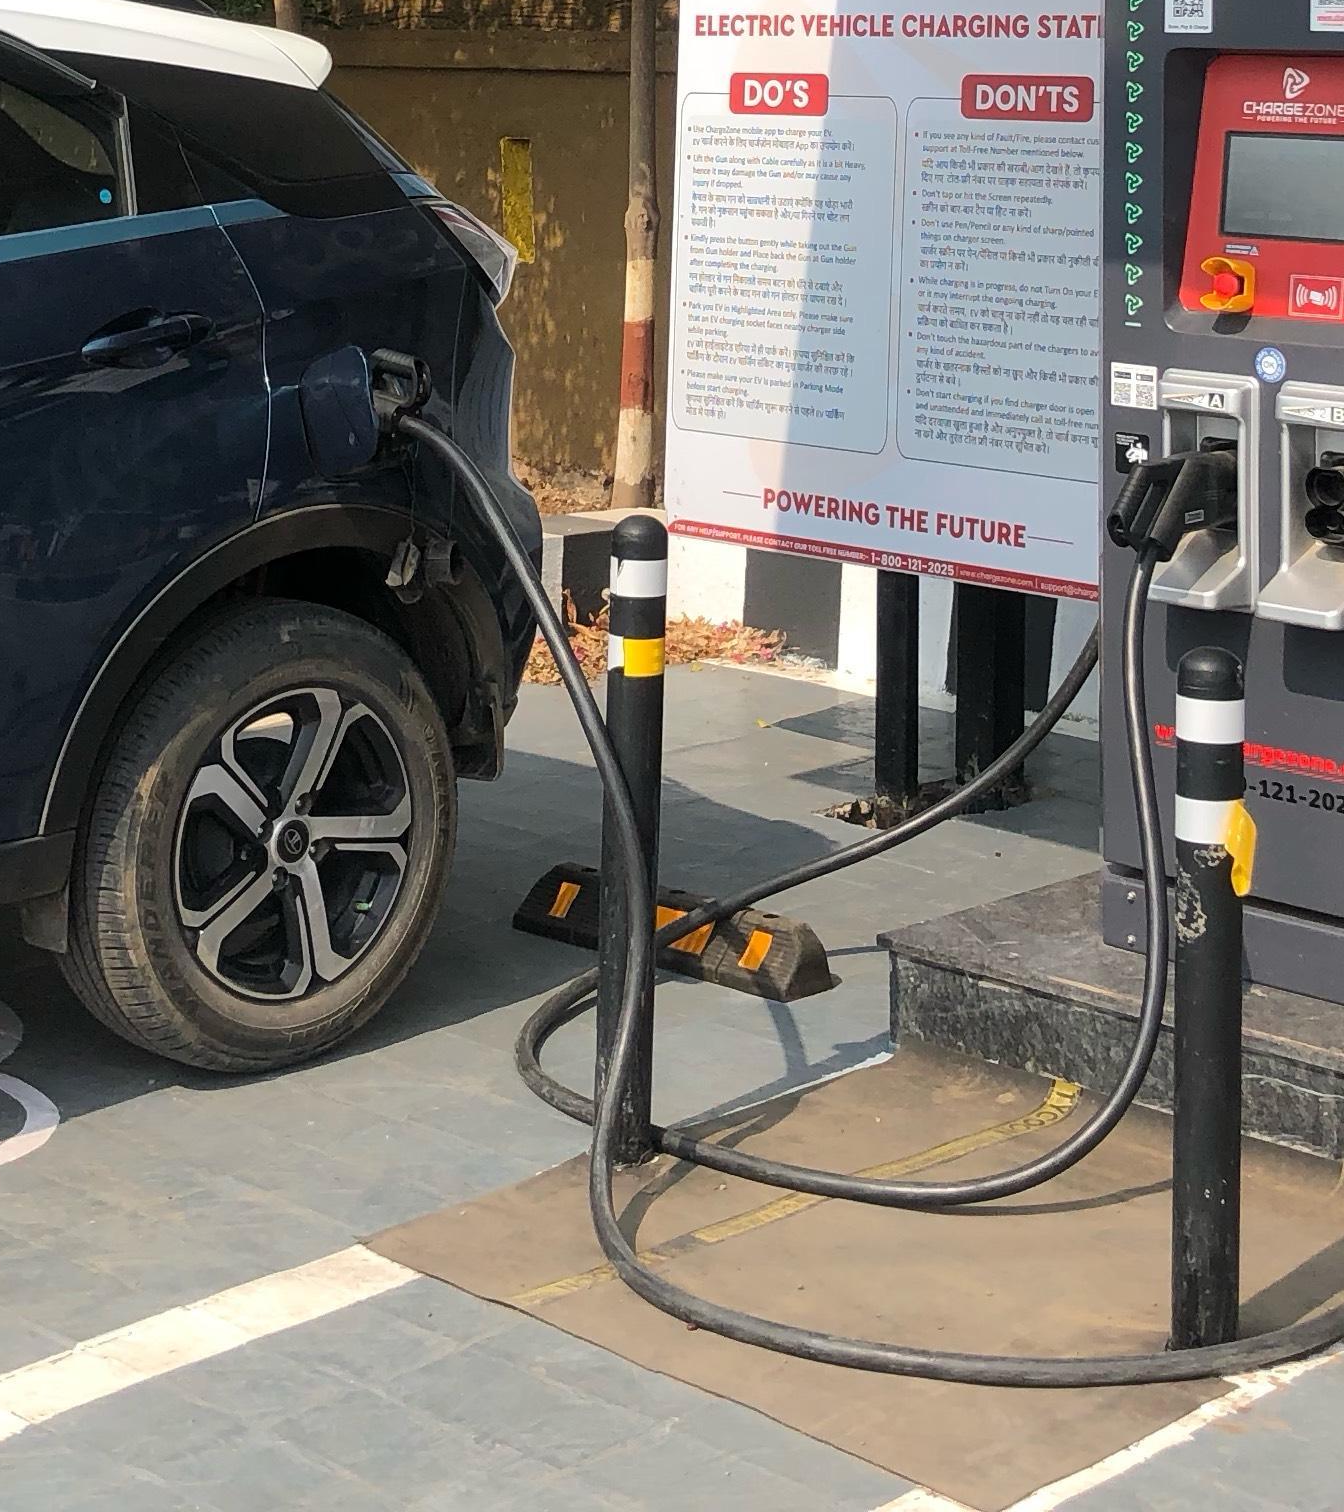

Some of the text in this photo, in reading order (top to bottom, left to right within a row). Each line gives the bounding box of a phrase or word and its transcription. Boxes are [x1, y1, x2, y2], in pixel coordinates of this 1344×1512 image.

[695, 14, 795, 37] ELECTRIC
[801, 14, 894, 37] VEHICLE
[901, 14, 1030, 38] CHARGING
[743, 79, 810, 108] DO'S
[975, 84, 1079, 113] DON'TS
[1262, 360, 1275, 370] OK
[1210, 394, 1223, 408] A
[762, 487, 1026, 548] POWERING THE FUTURE
[764, 537, 794, 549] CONTACT
[870, 551, 955, 576] 1-800-121-2025
